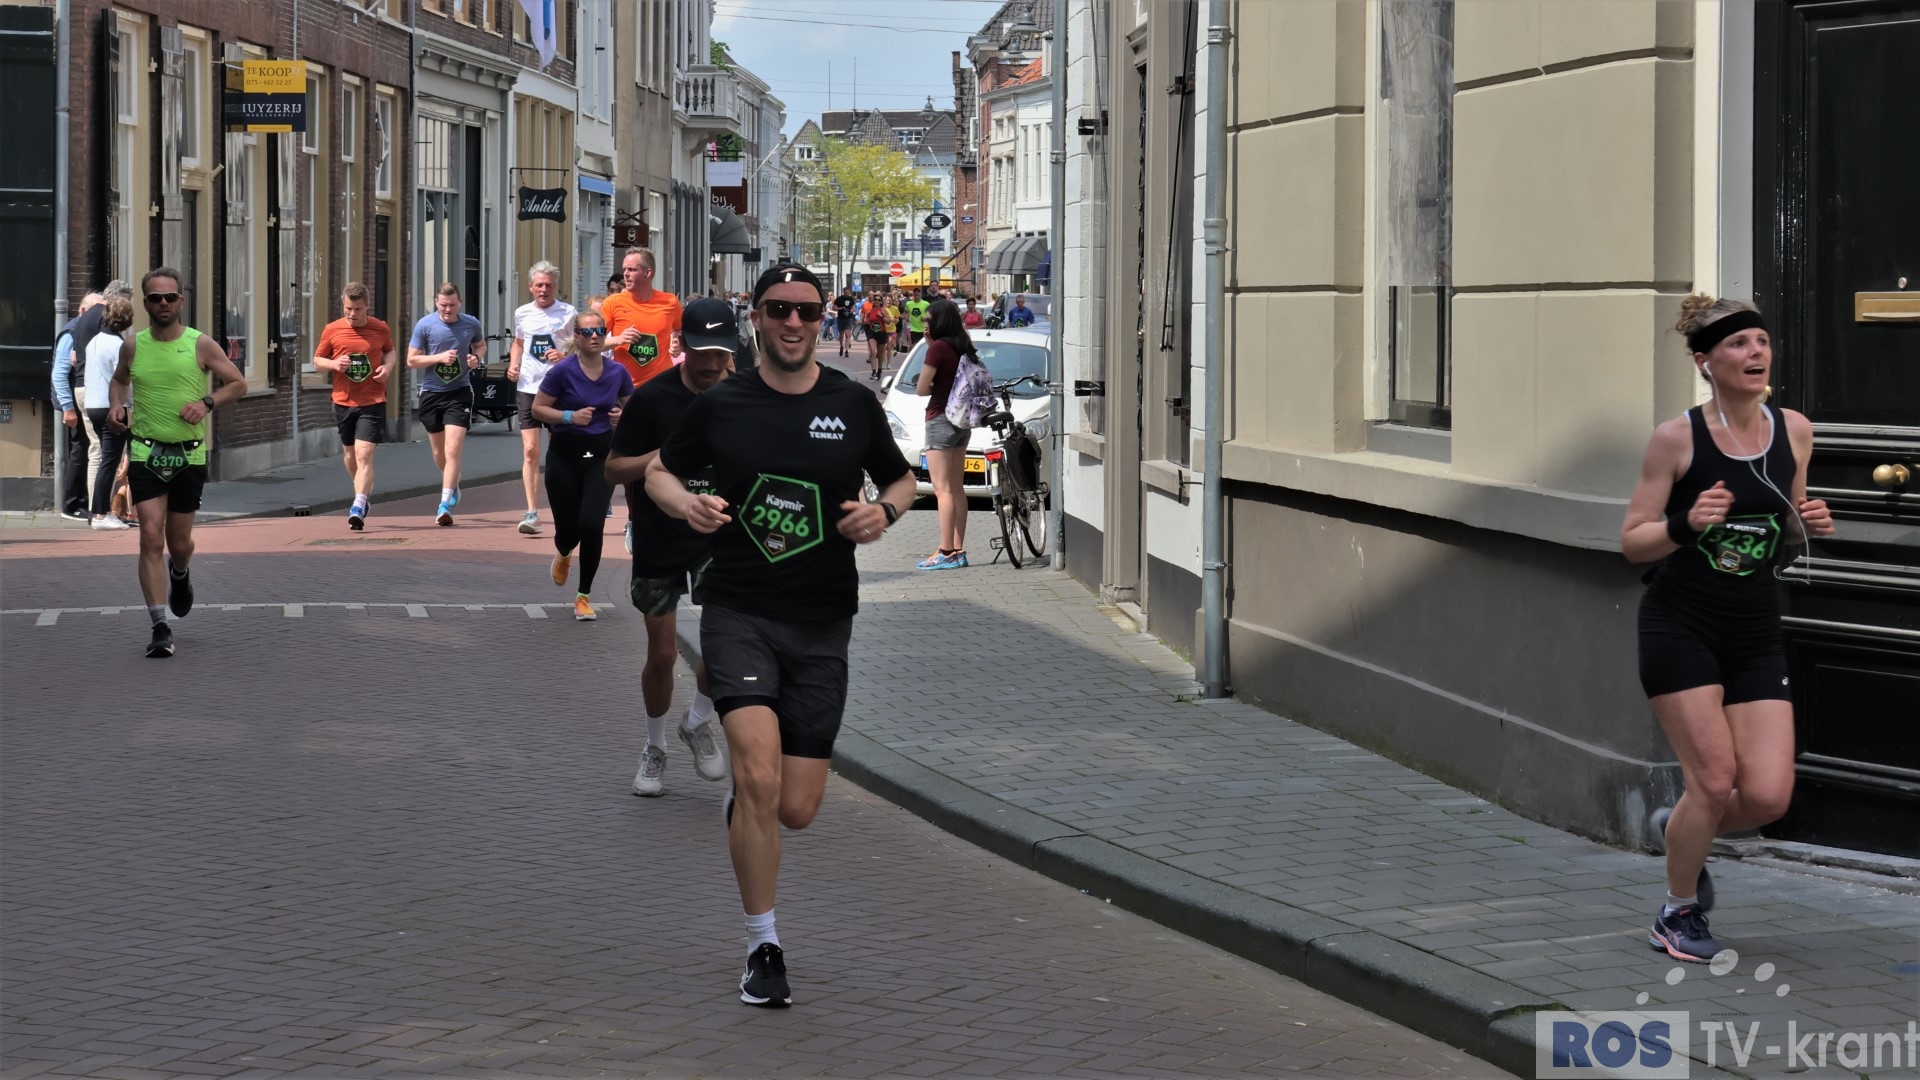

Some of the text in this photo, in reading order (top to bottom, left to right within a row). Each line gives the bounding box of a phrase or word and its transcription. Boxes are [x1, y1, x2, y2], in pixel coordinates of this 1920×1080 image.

[247, 67, 292, 77] TE KOOP
[521, 194, 563, 213] Antiek
[632, 345, 655, 356] 6005
[437, 366, 458, 374] 4532
[809, 431, 844, 440] TENKAY
[152, 455, 183, 467] 6370
[765, 493, 805, 512] Kaymir
[751, 505, 810, 537] 2966
[1708, 530, 1768, 560] 3236
